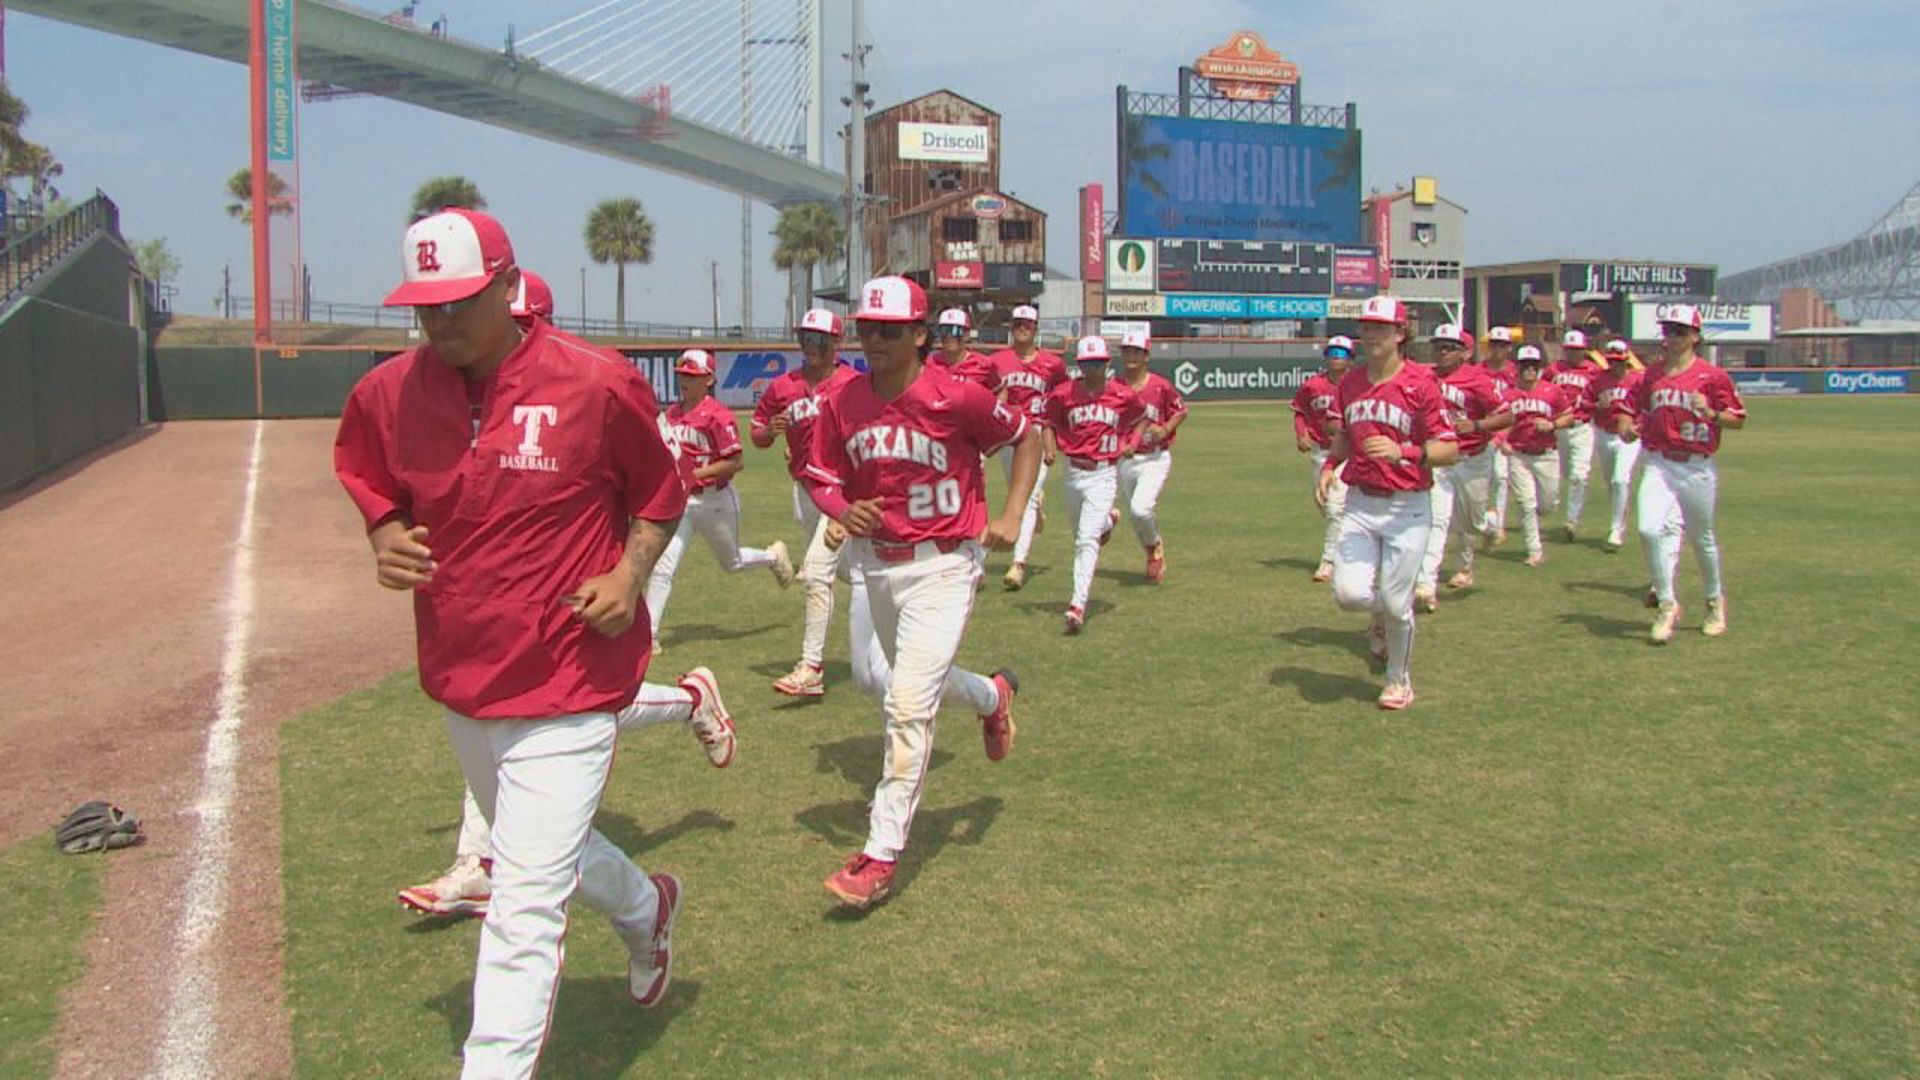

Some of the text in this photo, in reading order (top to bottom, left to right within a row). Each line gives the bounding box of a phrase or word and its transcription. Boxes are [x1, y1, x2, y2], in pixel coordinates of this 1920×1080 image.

[274, 14, 285, 33] or
[272, 36, 289, 83] home
[273, 88, 289, 156] delivery
[922, 131, 985, 149] Driscoll
[1176, 138, 1316, 206] BASEBALL
[416, 239, 441, 273] R
[1613, 264, 1649, 281] FLINT
[1651, 266, 1686, 283] HILLS
[1108, 299, 1149, 313] reliant
[1172, 299, 1324, 315] POWERING THE HOOKS
[1330, 301, 1363, 315] reliant
[1655, 302, 1751, 321] CNIERE
[1828, 373, 1902, 392] OxyChem
[1343, 398, 1412, 436] TEXANS
[513, 405, 558, 456] T
[846, 424, 949, 473] TEXANS
[499, 455, 559, 472] BASEBALL
[906, 479, 961, 520] 20
